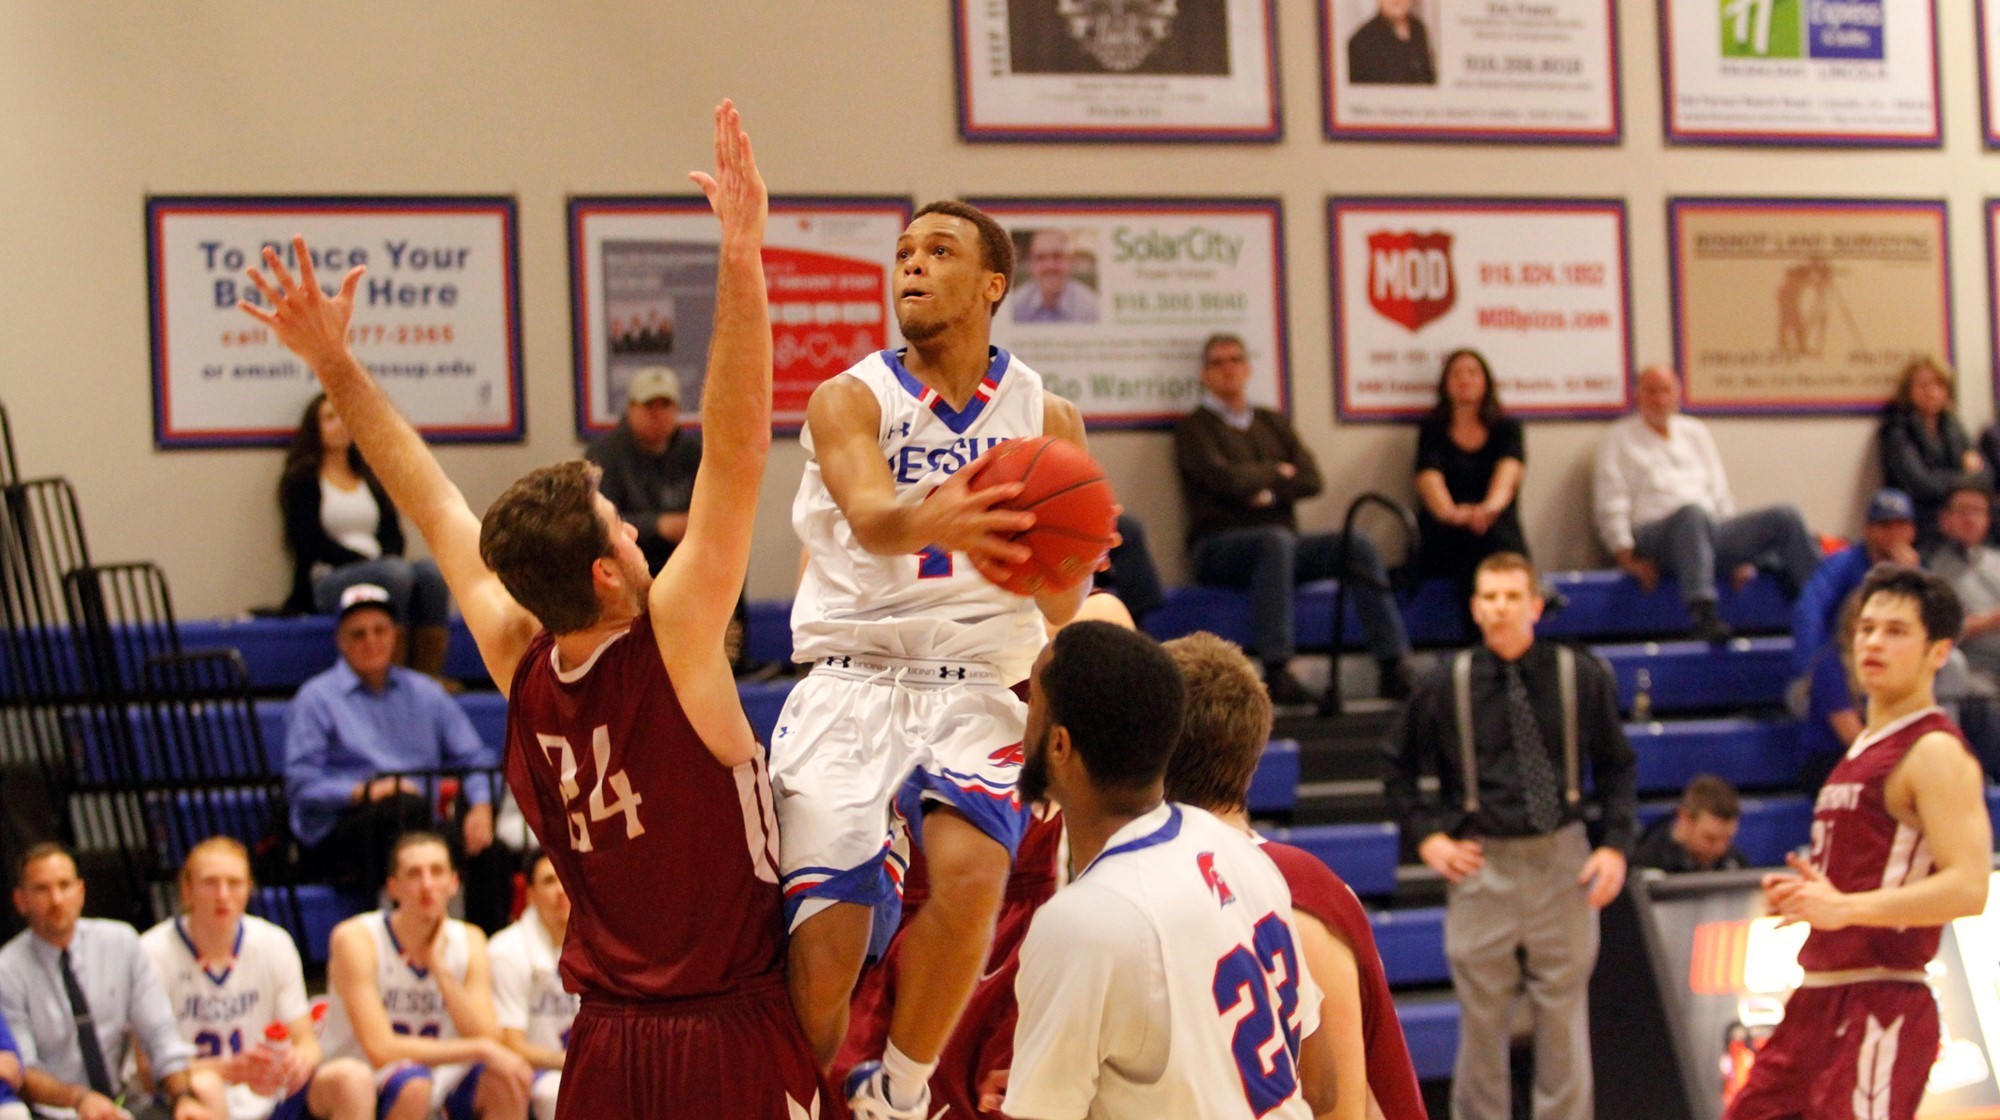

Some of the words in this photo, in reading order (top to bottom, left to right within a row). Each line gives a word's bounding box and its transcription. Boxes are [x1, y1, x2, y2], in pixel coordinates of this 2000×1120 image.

[199, 241, 244, 271] To
[384, 239, 472, 270] Your
[1110, 225, 1244, 268] SolarCity
[367, 278, 459, 308] Here
[1373, 249, 1449, 301] MOD
[535, 723, 646, 854] 24
[1211, 909, 1302, 1120] 22
